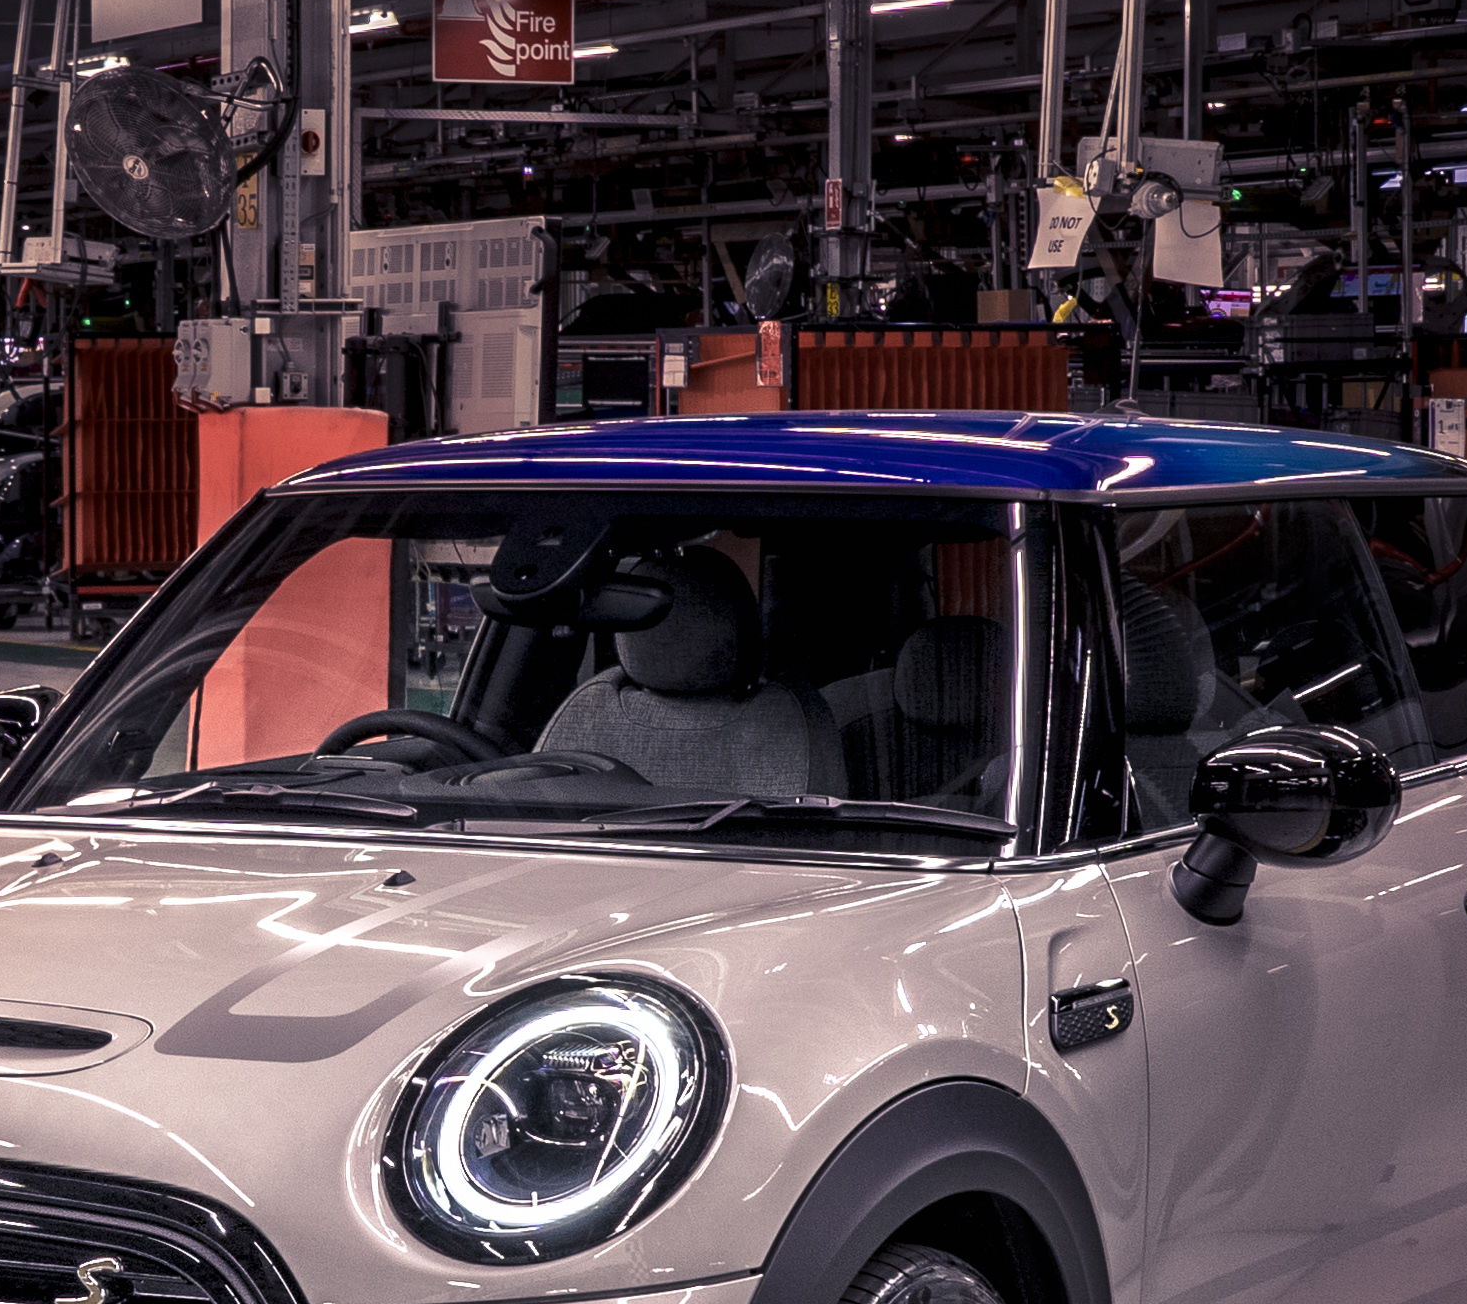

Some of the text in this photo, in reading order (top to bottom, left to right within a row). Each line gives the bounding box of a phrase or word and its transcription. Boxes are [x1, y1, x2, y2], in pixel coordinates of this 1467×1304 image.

[516, 11, 556, 34] Fire
[516, 38, 570, 65] point
[237, 194, 257, 227] 35
[1049, 217, 1082, 230] DO NOT
[1048, 240, 1065, 254] USE
[1103, 1005, 1120, 1032] S
